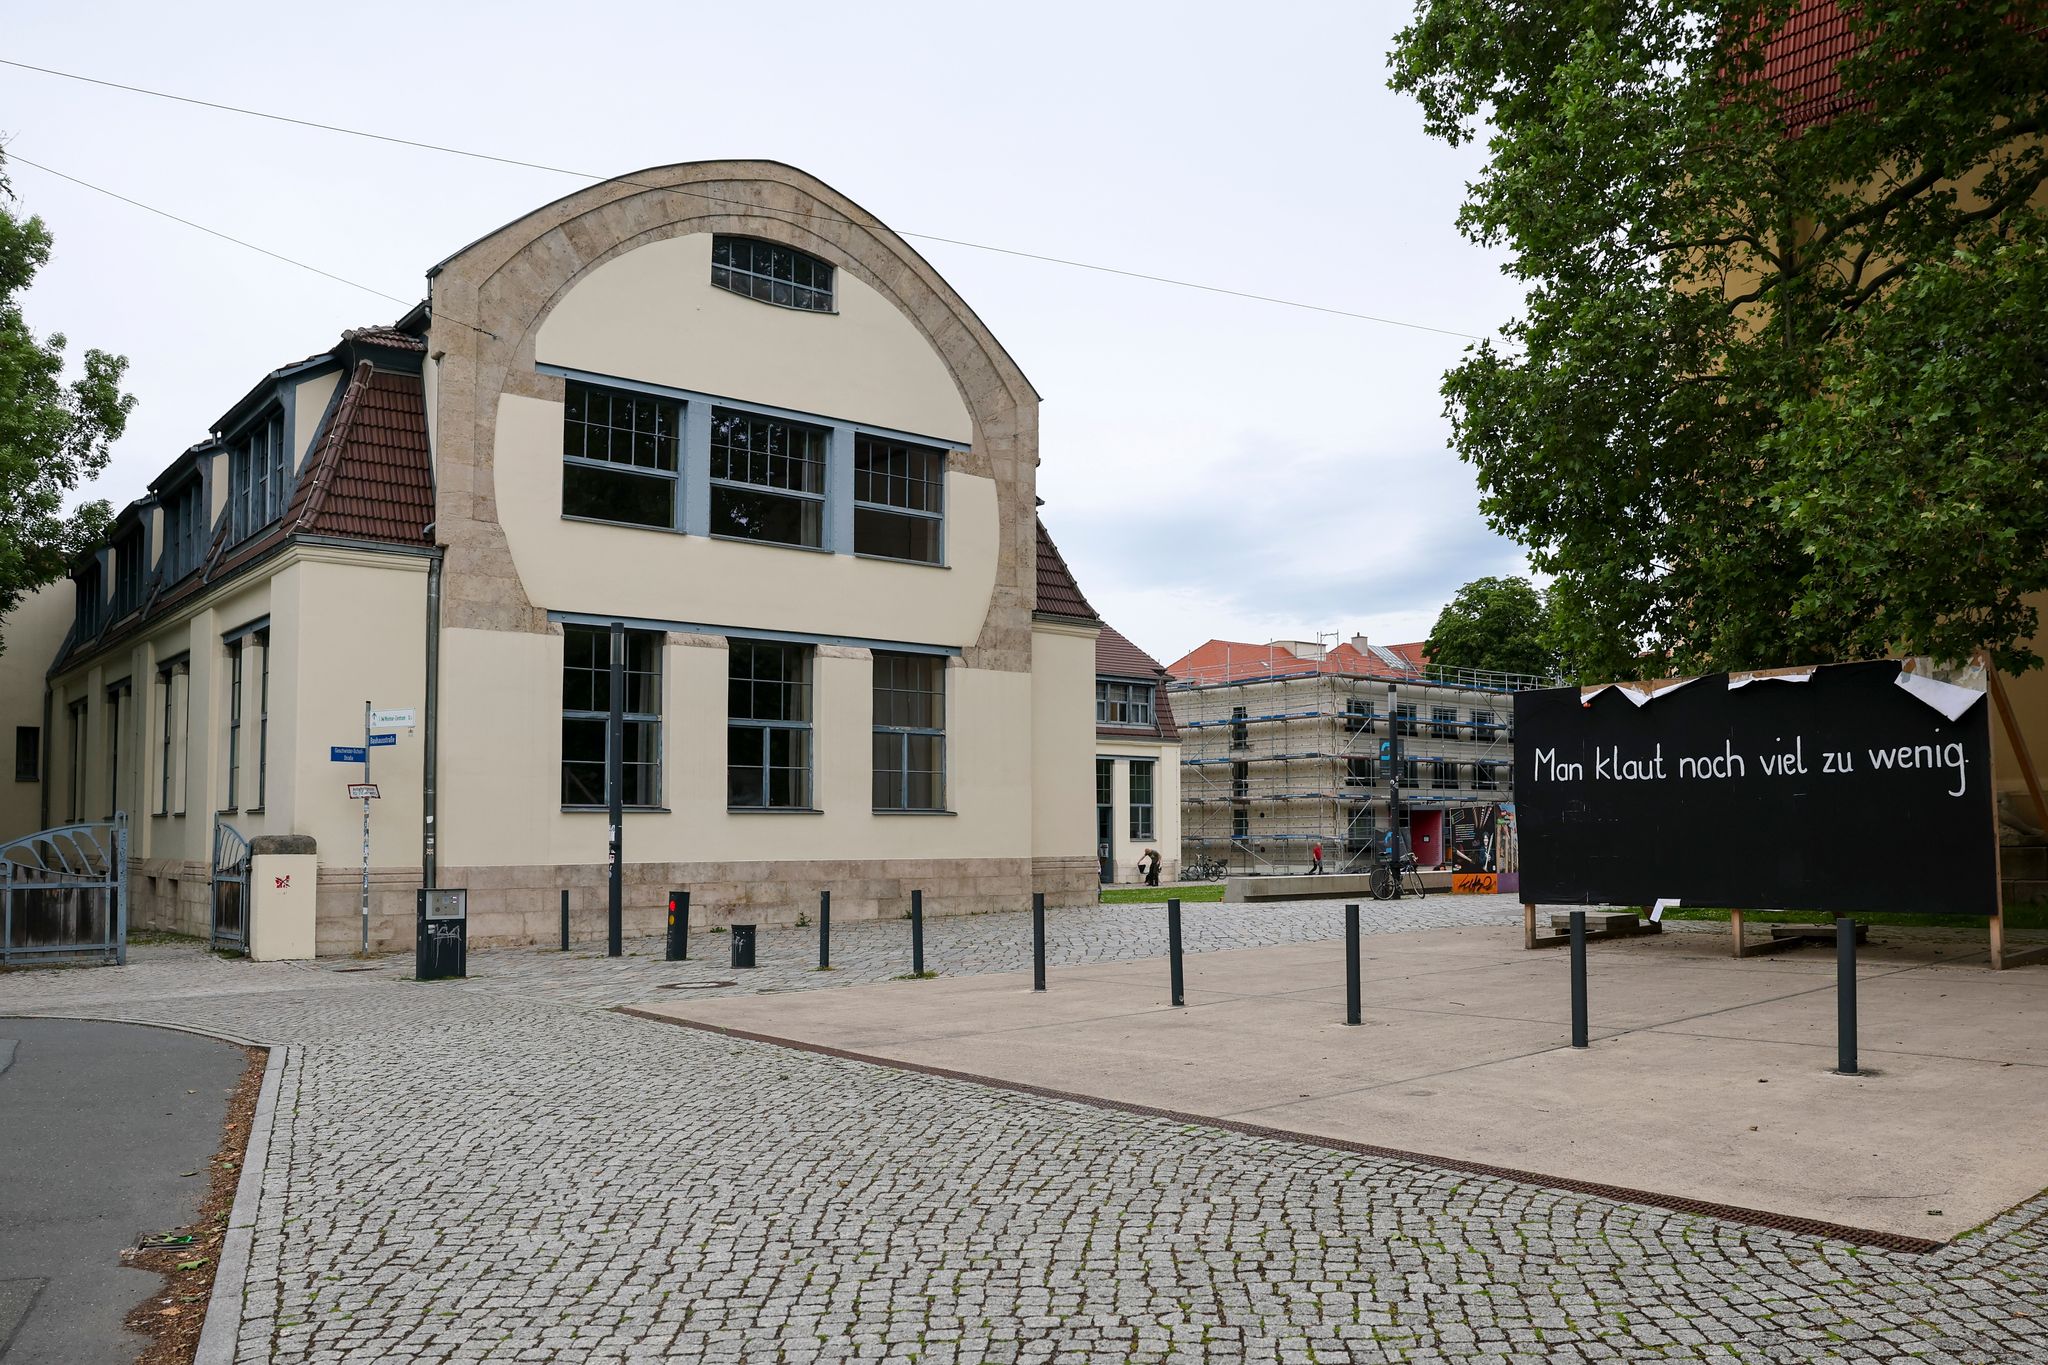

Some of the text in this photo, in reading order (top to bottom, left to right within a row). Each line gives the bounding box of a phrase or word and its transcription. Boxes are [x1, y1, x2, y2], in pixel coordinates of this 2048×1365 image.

[1534, 747, 1583, 782] Man
[1595, 742, 1667, 781] klaut
[1679, 738, 1745, 780] noch
[1759, 735, 1808, 776] viel
[1822, 751, 1855, 774] zu
